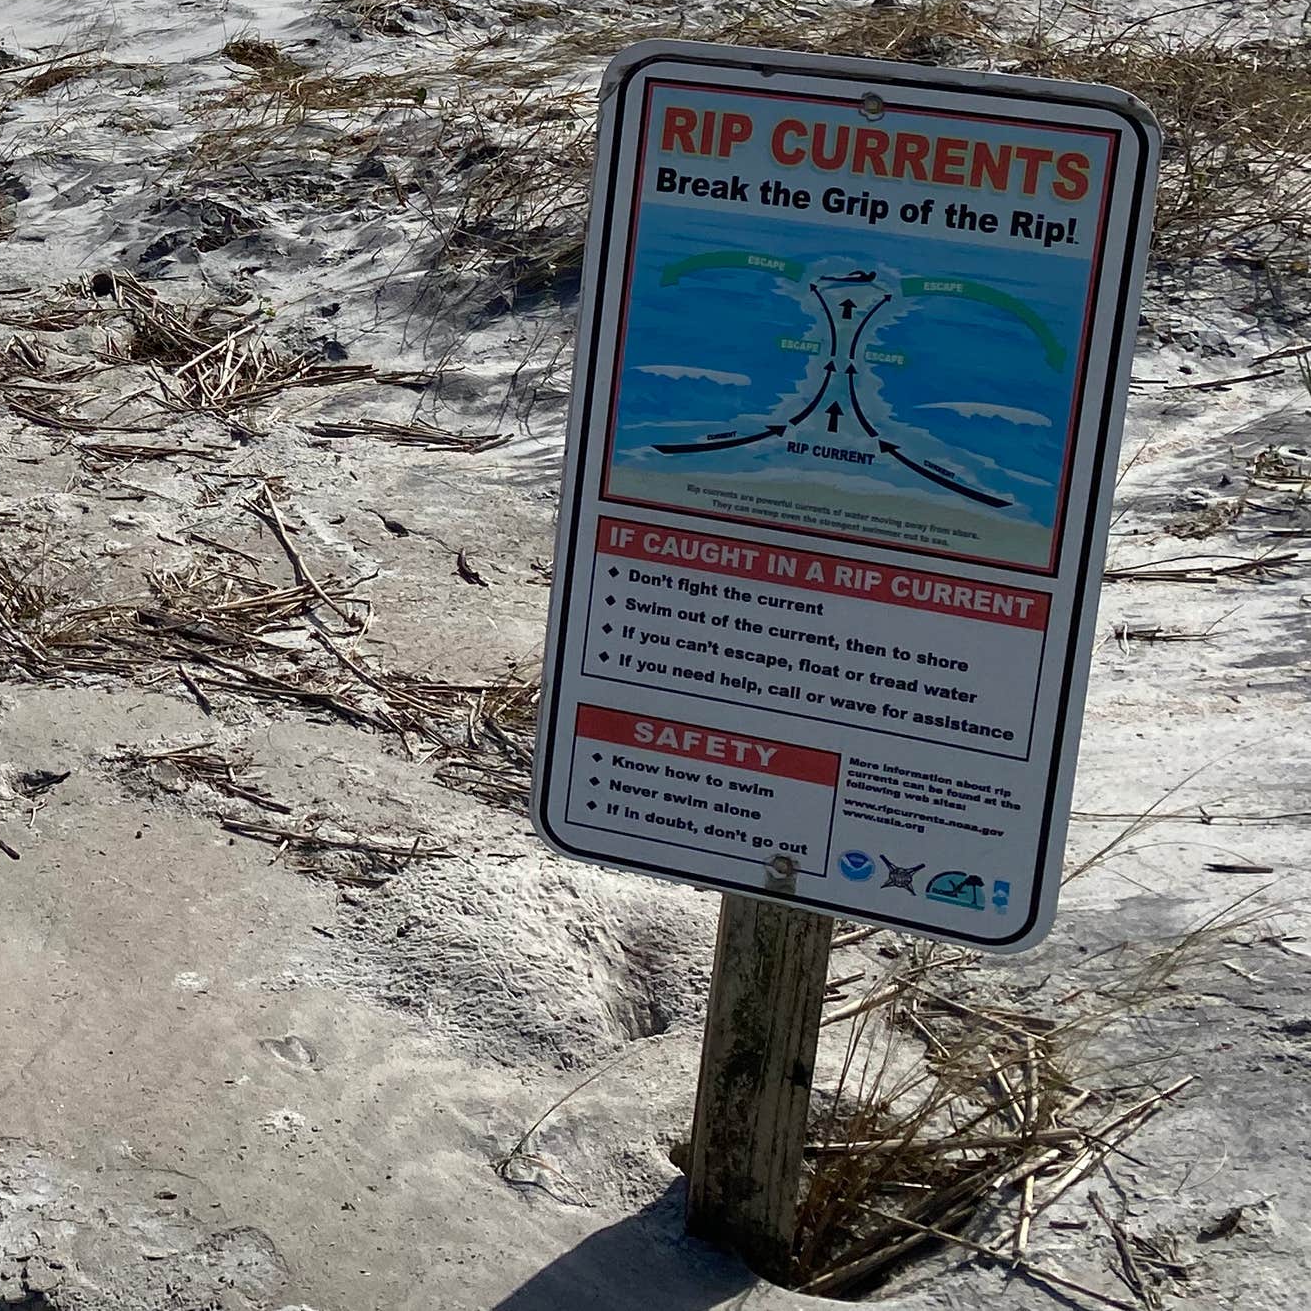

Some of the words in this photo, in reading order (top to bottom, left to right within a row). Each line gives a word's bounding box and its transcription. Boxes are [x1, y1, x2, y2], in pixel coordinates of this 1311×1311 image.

[662, 107, 753, 157] RIP
[771, 119, 1089, 200] CURRENTS
[656, 167, 750, 202] Break
[759, 180, 811, 209] the
[822, 187, 889, 224] Grip
[900, 200, 935, 224] of
[945, 203, 998, 233] the
[1010, 211, 1079, 247] Rip!
[748, 256, 785, 271] ESCAPE
[924, 282, 963, 292] ESCAPE
[781, 340, 819, 353] ESCAPE
[865, 352, 904, 365] ESCAPE
[787, 441, 809, 455] RIP
[813, 445, 875, 465] CURRENT
[713, 499, 732, 511] They
[871, 516, 902, 528] moving
[610, 526, 635, 548] IF
[643, 532, 760, 570] CAUGHT
[767, 554, 798, 577] IN
[805, 561, 825, 583] A
[834, 565, 882, 592] RIP
[891, 576, 1034, 619] CURRENT
[628, 569, 673, 589] Don't
[678, 577, 718, 597] fight
[723, 586, 752, 602] the
[757, 595, 824, 616] current
[625, 598, 672, 617] Swim
[678, 609, 706, 624] out
[711, 614, 729, 628] of
[735, 617, 762, 634] the
[768, 626, 839, 651] current,
[846, 638, 886, 657] then
[893, 647, 911, 661] to
[917, 652, 968, 672] shore
[622, 625, 635, 639] If
[639, 630, 671, 645] you
[676, 638, 719, 656] can't
[724, 646, 792, 672] escape,
[799, 658, 840, 678] float
[845, 668, 864, 682] or
[869, 671, 918, 693] tread
[923, 683, 977, 703] water
[619, 653, 632, 667] If
[636, 658, 667, 673] you
[672, 667, 715, 683] need
[720, 672, 762, 695] help,
[768, 683, 801, 700] call
[806, 689, 825, 704] or
[830, 696, 877, 714] wave
[882, 704, 908, 720] for
[913, 710, 1014, 741] assistance
[634, 721, 778, 767] SAFETY
[612, 755, 660, 774] Know
[664, 766, 701, 783] how
[706, 774, 723, 788] to
[728, 780, 774, 798] swim
[846, 780, 901, 799] following
[905, 792, 929, 803] web
[933, 798, 966, 811] sites:
[848, 769, 899, 786] currents
[903, 781, 924, 791] can
[929, 784, 943, 794] be
[946, 788, 980, 802] found
[984, 796, 997, 805] at
[1001, 800, 1021, 810] the
[849, 757, 879, 770] More
[883, 764, 952, 785] information
[956, 779, 991, 793] about
[994, 787, 1011, 798] rip
[609, 779, 659, 799] Never
[663, 790, 708, 810] swim
[714, 802, 761, 820] alone
[844, 798, 1004, 837] www.ripcurrents.noaa.gov
[607, 804, 619, 815] If
[625, 807, 639, 820] in
[645, 810, 698, 834] doubt,
[704, 824, 747, 843] don't
[752, 836, 773, 848] go
[779, 840, 808, 855] out
